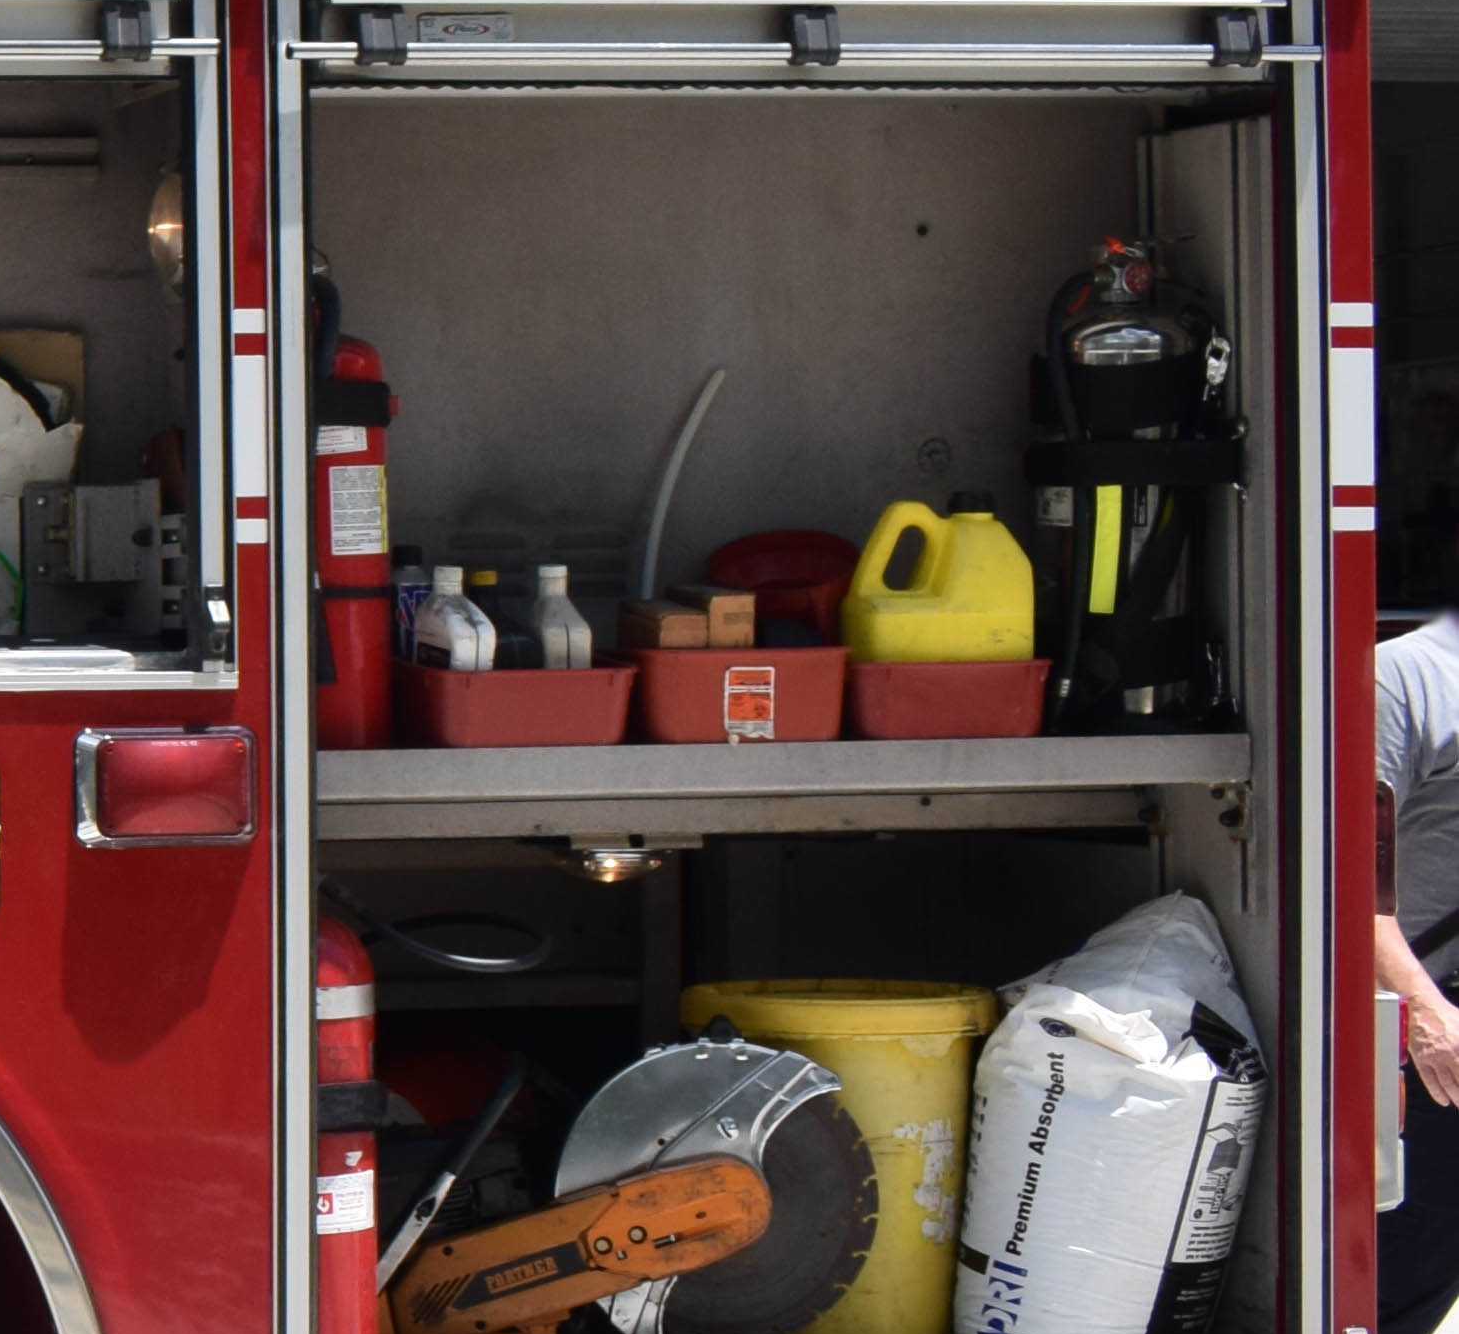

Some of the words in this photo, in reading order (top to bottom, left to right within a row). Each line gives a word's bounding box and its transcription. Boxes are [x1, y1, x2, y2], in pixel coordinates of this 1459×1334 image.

[1004, 1162, 1042, 1257] Premium
[1028, 1051, 1065, 1156] Absorbent
[485, 1256, 558, 1290] PARTNER
